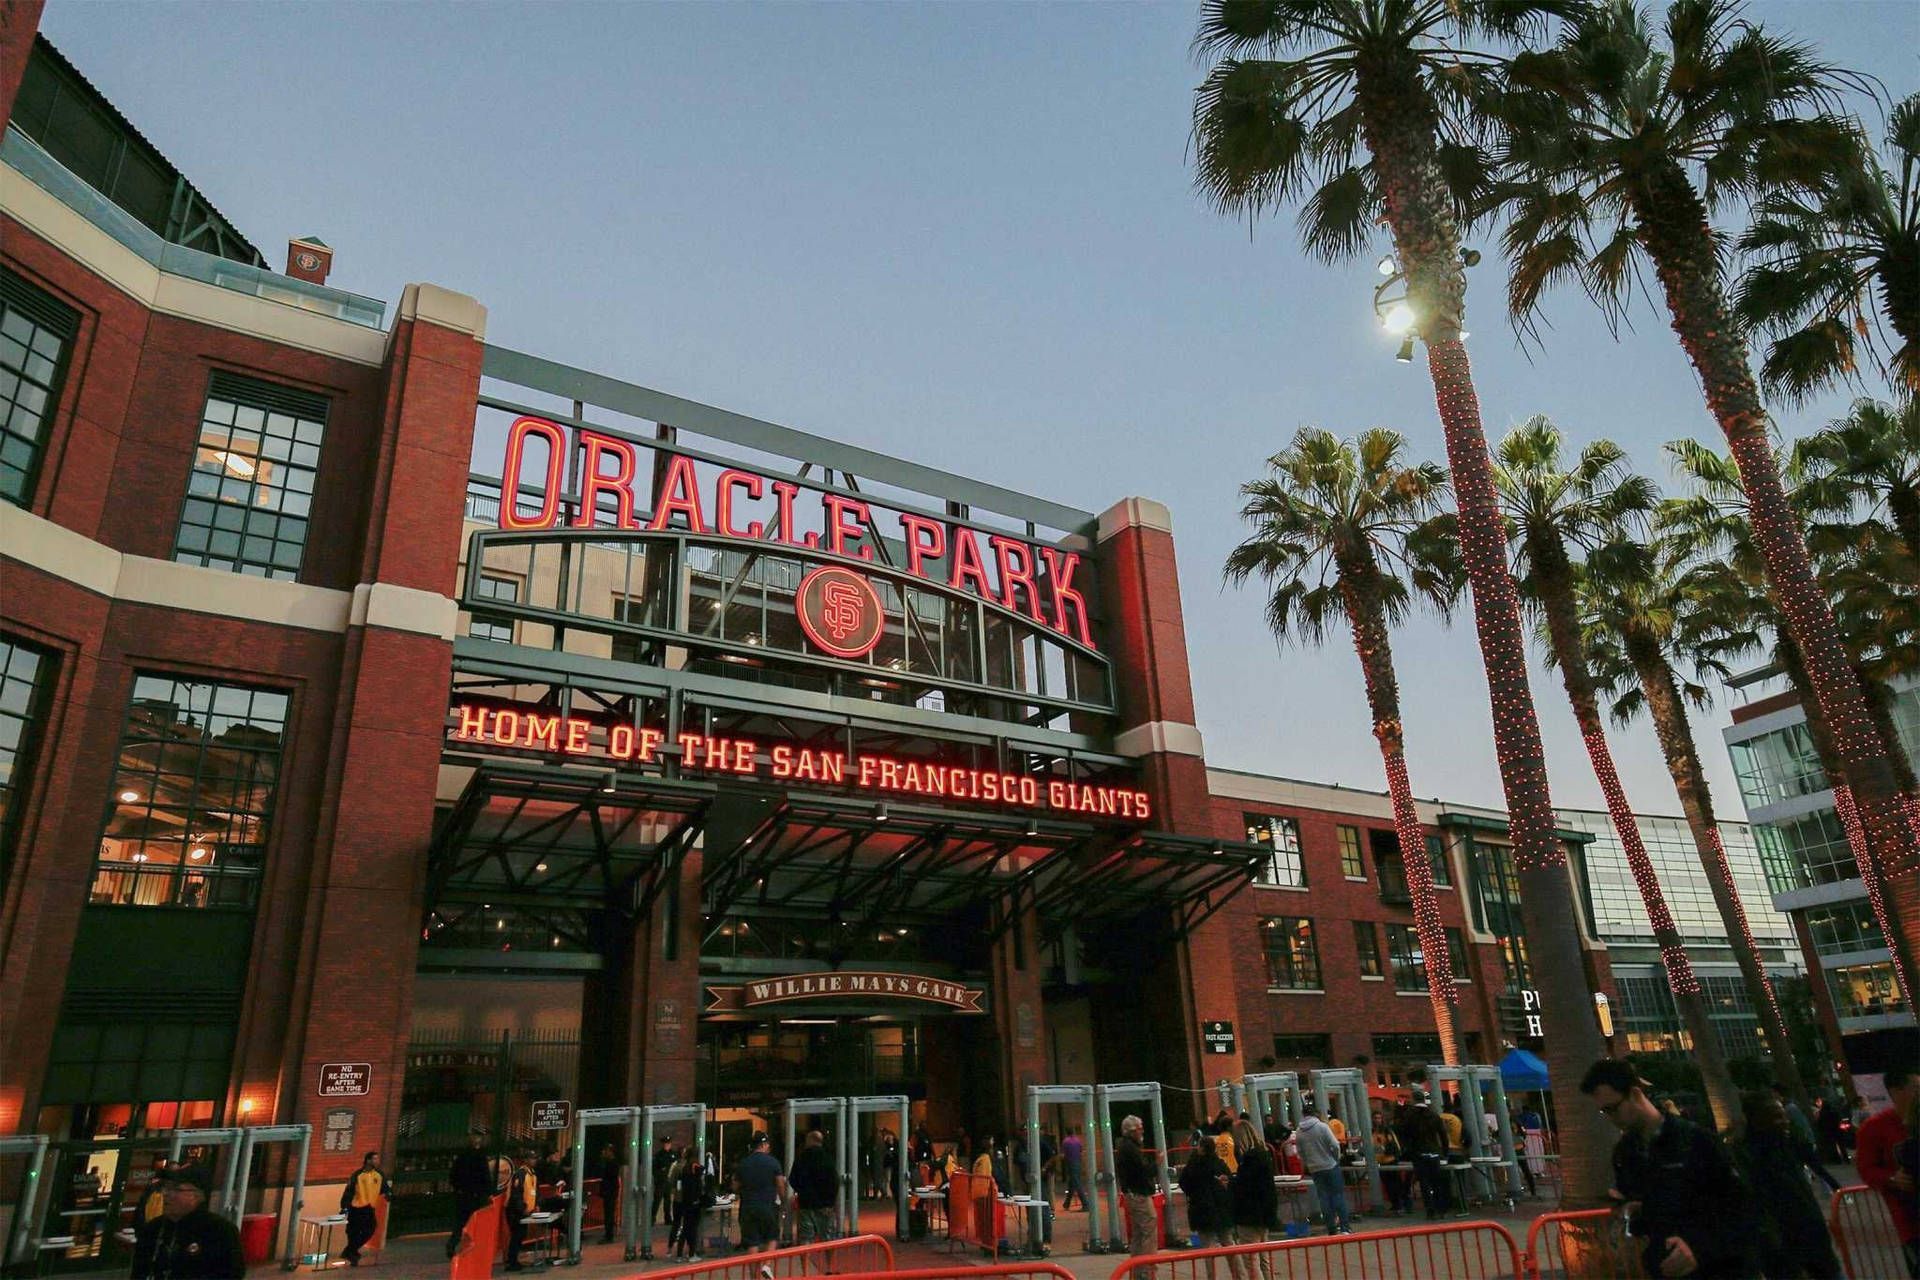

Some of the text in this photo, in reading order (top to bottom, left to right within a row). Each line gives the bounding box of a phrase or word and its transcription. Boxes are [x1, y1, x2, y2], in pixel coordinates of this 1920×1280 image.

[499, 415, 1096, 650] ORACLE PARK
[457, 704, 1151, 819] HOME OF THE SAN FRANCISCO GIANTS
[753, 976, 965, 1003] WILLIE MAYS GATE
